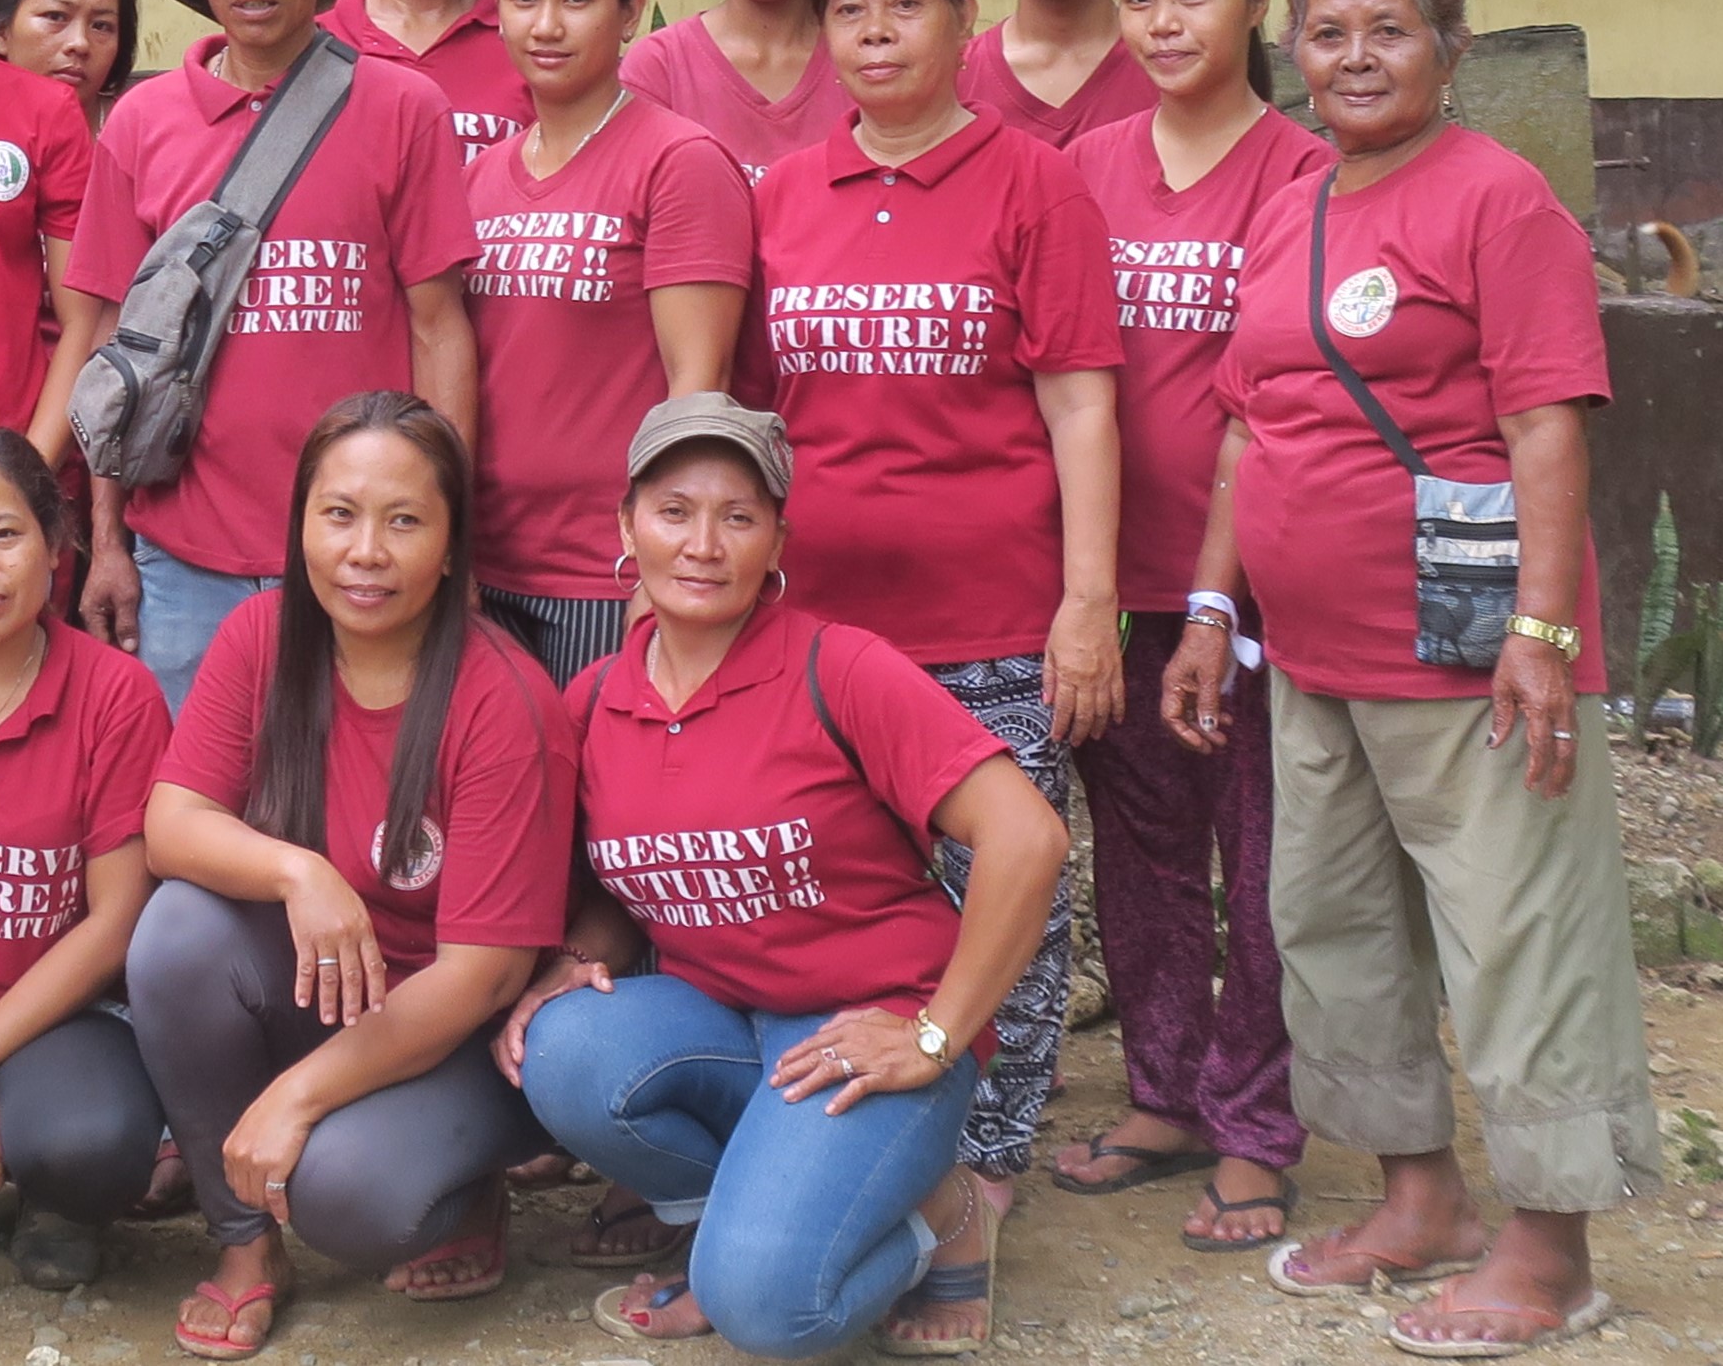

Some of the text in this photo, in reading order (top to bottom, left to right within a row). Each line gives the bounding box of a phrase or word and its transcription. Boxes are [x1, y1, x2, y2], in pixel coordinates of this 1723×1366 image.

[474, 211, 622, 242] RESERVE
[251, 239, 367, 270] ERVE
[473, 242, 574, 273] TURE
[238, 275, 333, 308] URE
[469, 274, 512, 296] OUR
[769, 283, 994, 316] PRESERVE
[1114, 270, 1213, 305] URE
[227, 309, 363, 334] UR NATURE
[770, 316, 949, 352] FUTURE
[821, 351, 875, 375] OUR
[878, 352, 988, 376] NATURE
[587, 817, 814, 871] PRESERVE
[663, 904, 713, 928] OUR
[715, 880, 826, 927] NATURE
